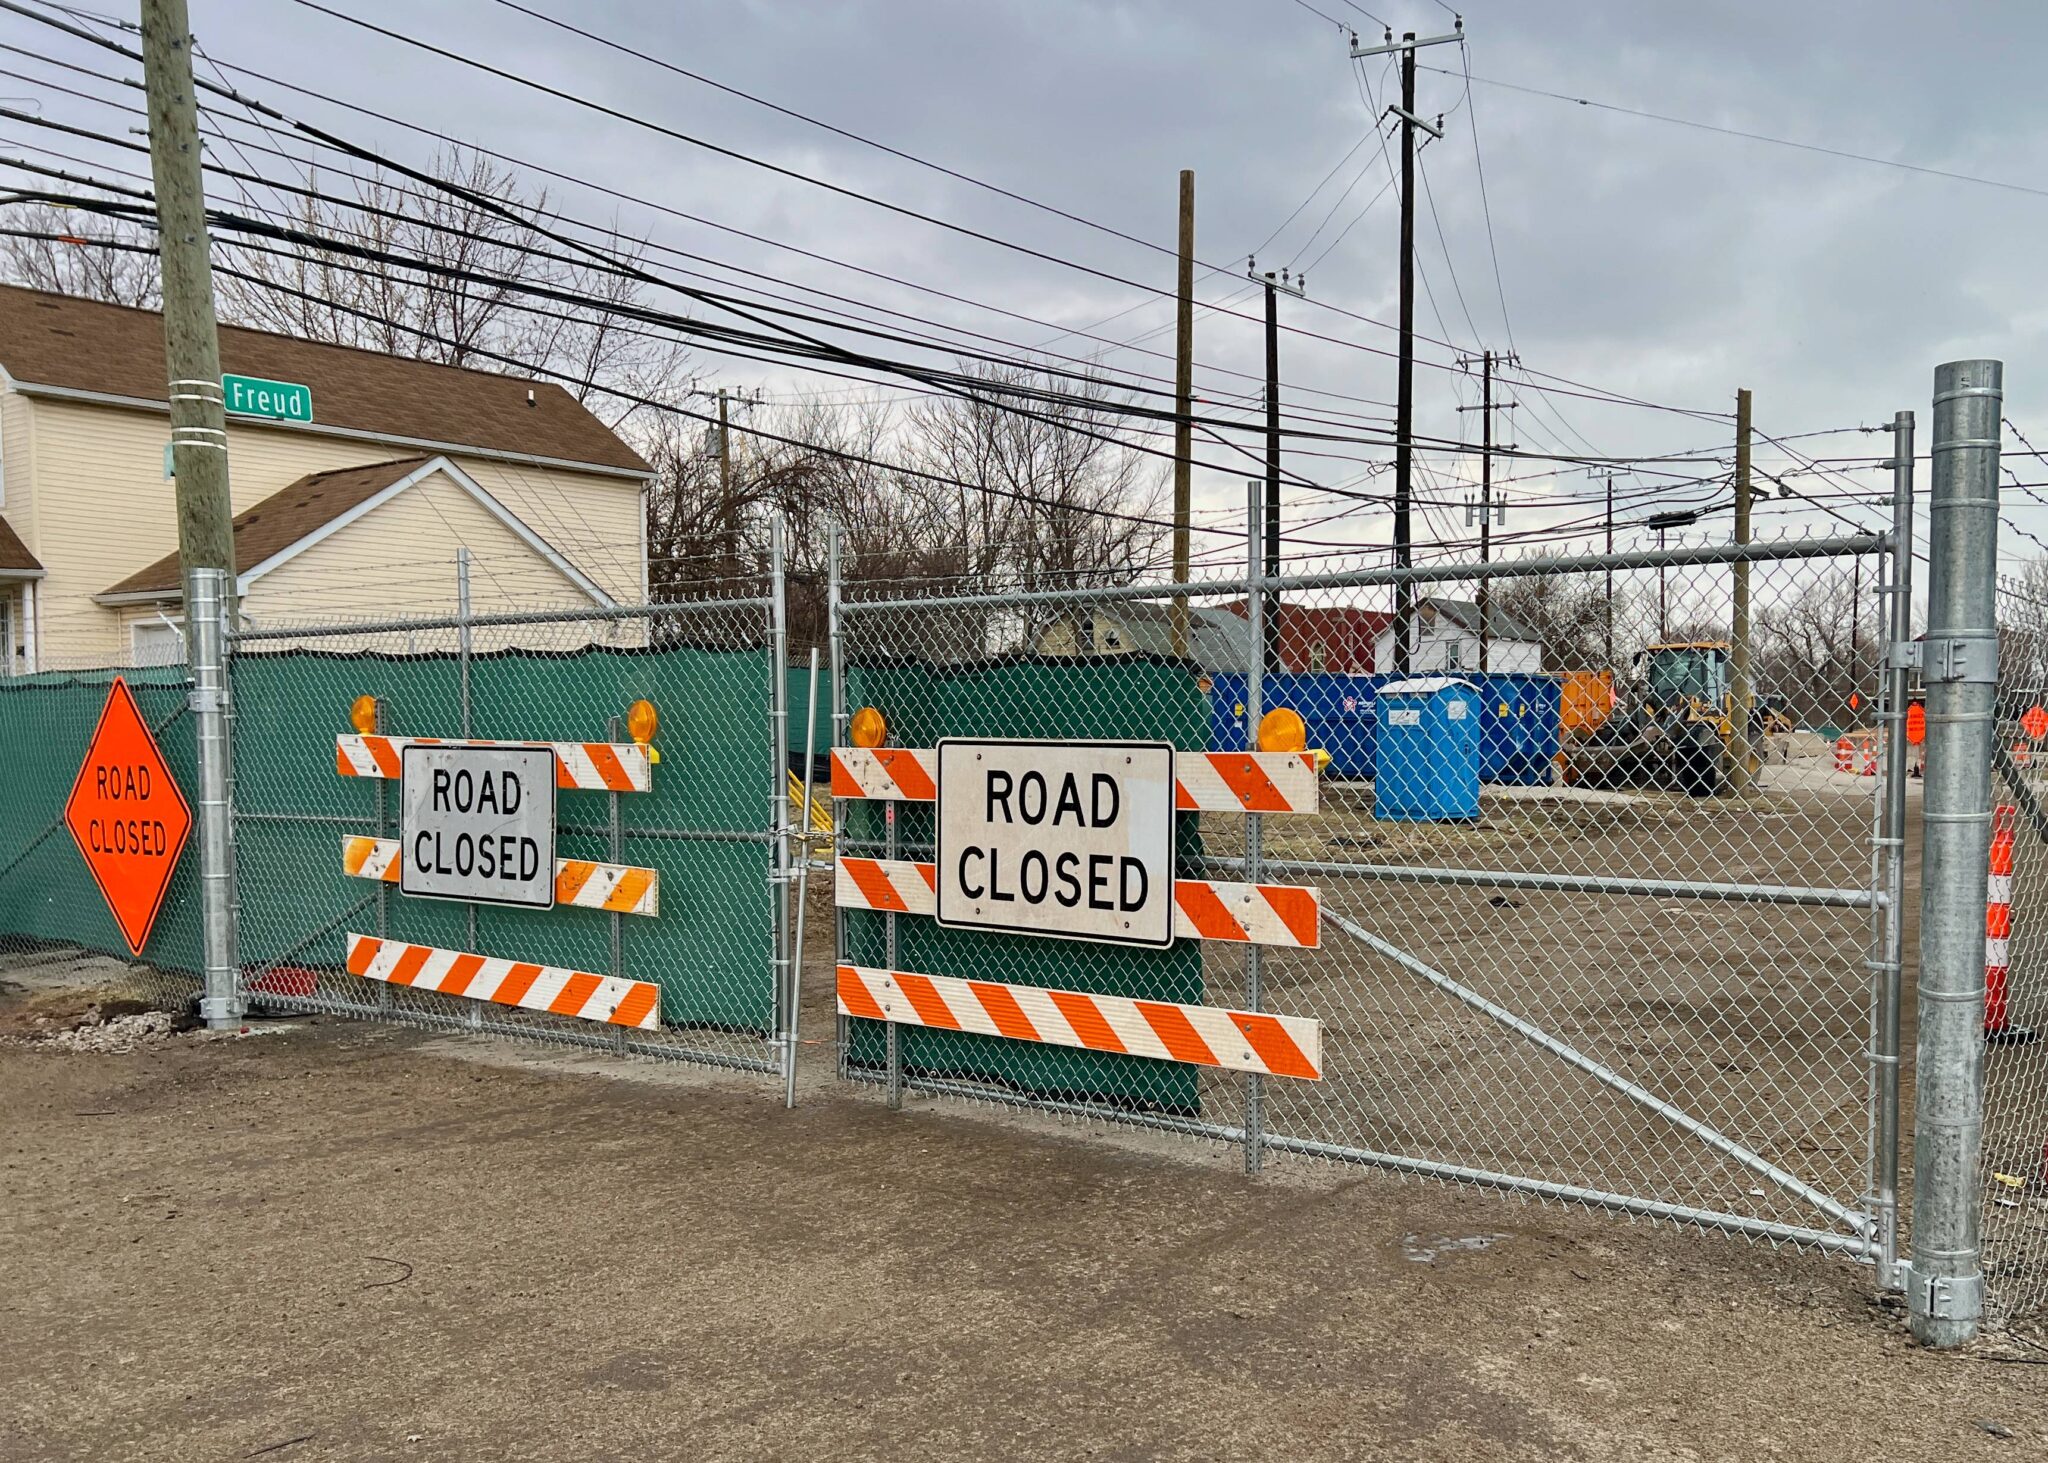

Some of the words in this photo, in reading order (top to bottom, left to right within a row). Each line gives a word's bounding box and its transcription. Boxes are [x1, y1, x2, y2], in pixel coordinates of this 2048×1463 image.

[233, 382, 302, 416] Freud
[97, 765, 150, 801] ROAD
[433, 768, 521, 815] ROAD
[986, 769, 1120, 828] ROAD
[90, 819, 166, 856] CLOSED
[415, 830, 539, 881] CLOSED
[958, 845, 1148, 912] CLOSED
